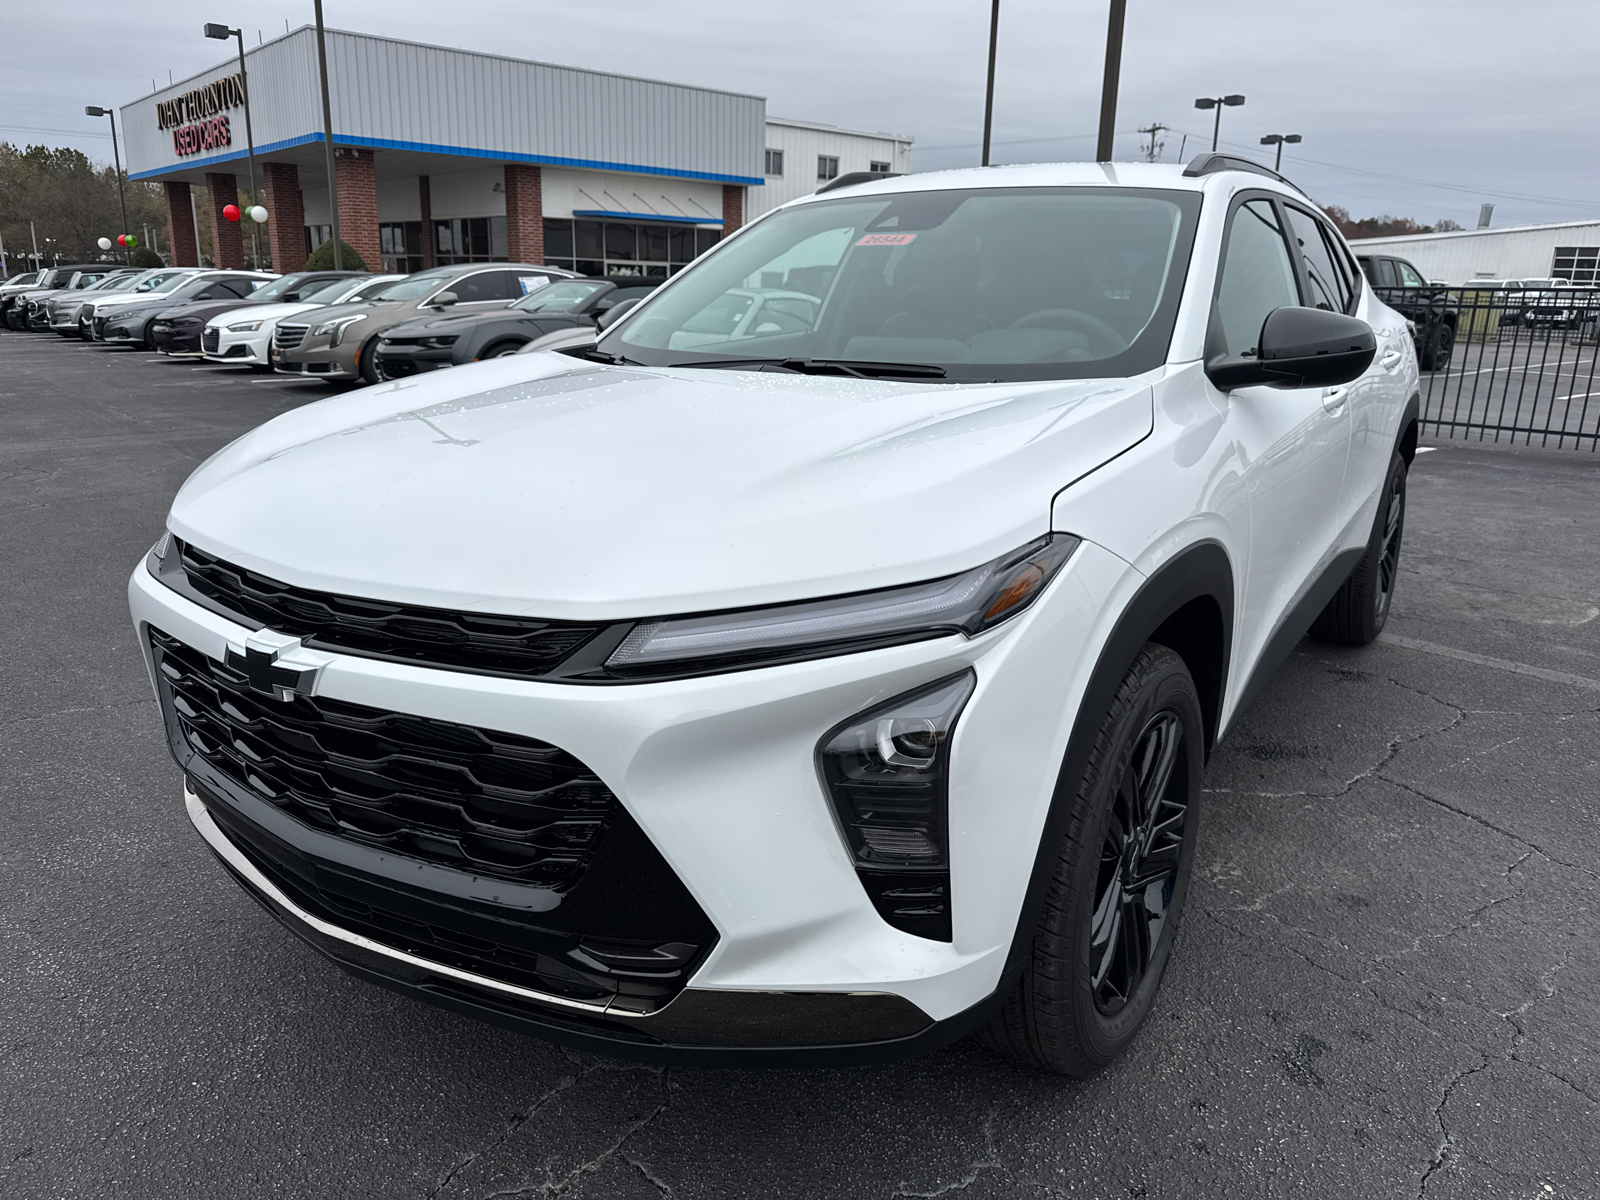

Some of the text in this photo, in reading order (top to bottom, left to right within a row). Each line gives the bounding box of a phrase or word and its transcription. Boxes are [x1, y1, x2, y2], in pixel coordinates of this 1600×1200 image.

[156, 72, 247, 130] JOHN THORNTON
[172, 115, 230, 156] USED CARS
[864, 235, 906, 244] 26544
